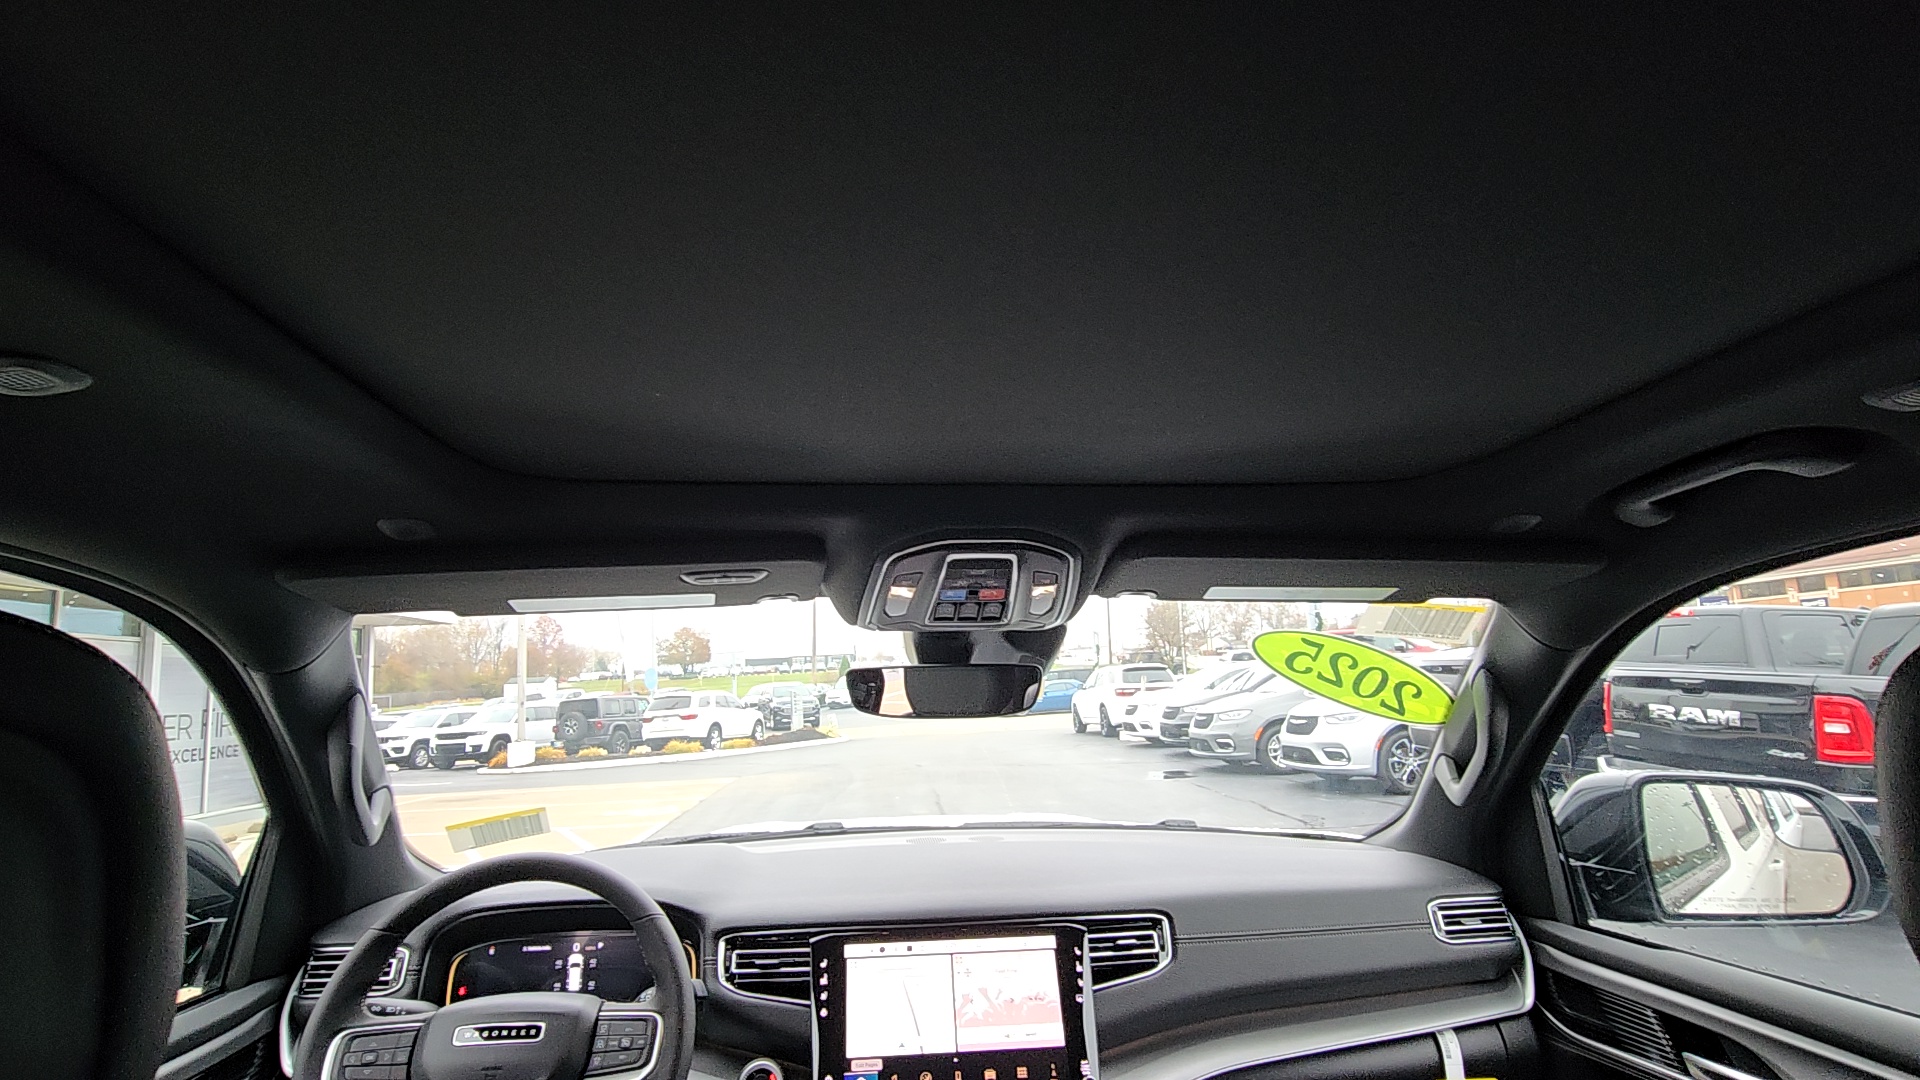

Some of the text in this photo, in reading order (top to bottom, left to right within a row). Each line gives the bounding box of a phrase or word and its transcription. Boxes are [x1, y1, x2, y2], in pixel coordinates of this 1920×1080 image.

[1648, 703, 1741, 728] RAM
[168, 744, 240, 764] XCELENCE
[463, 1028, 538, 1039] WAGONEER
